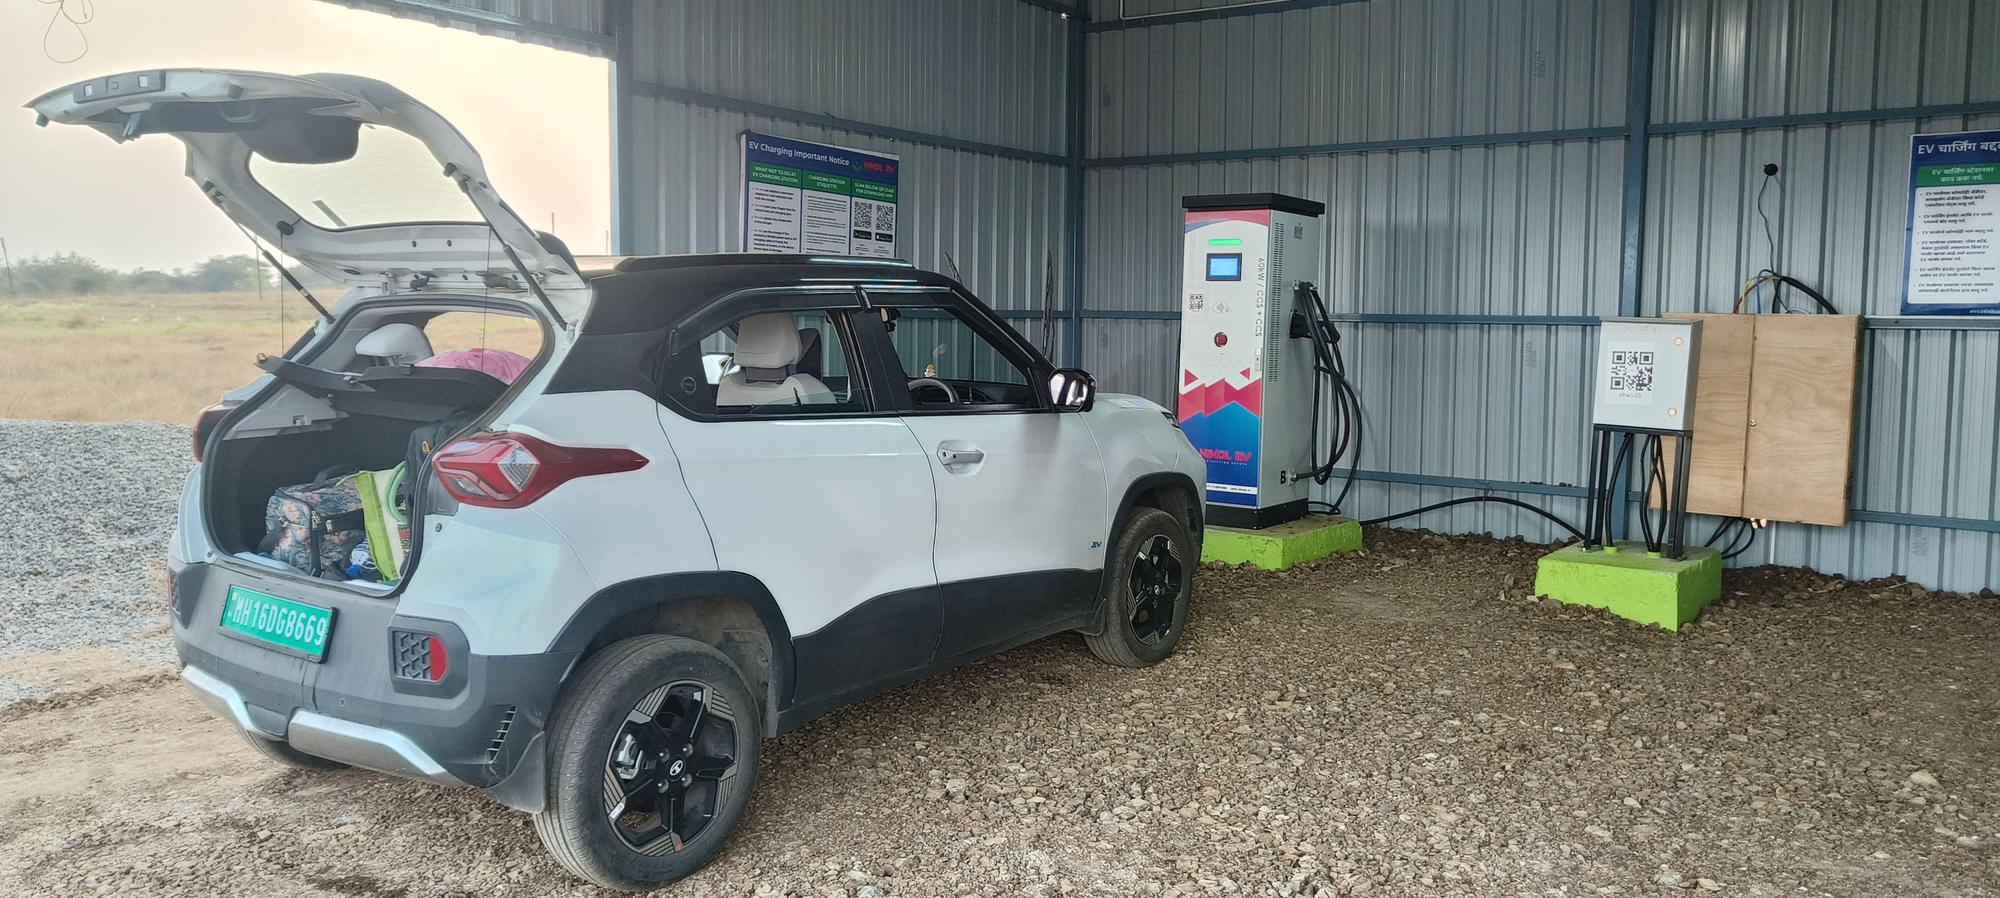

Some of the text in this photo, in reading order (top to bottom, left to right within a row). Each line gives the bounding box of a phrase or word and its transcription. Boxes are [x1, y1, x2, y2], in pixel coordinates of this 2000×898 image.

[749, 141, 850, 166] EV Charging Important Notice
[1918, 144, 1934, 154] EV
[1937, 140, 1977, 152] चार्जिंग
[1256, 290, 1264, 308] CCS
[1255, 318, 1263, 337] CCS
[232, 596, 327, 646] MH16DG8669
